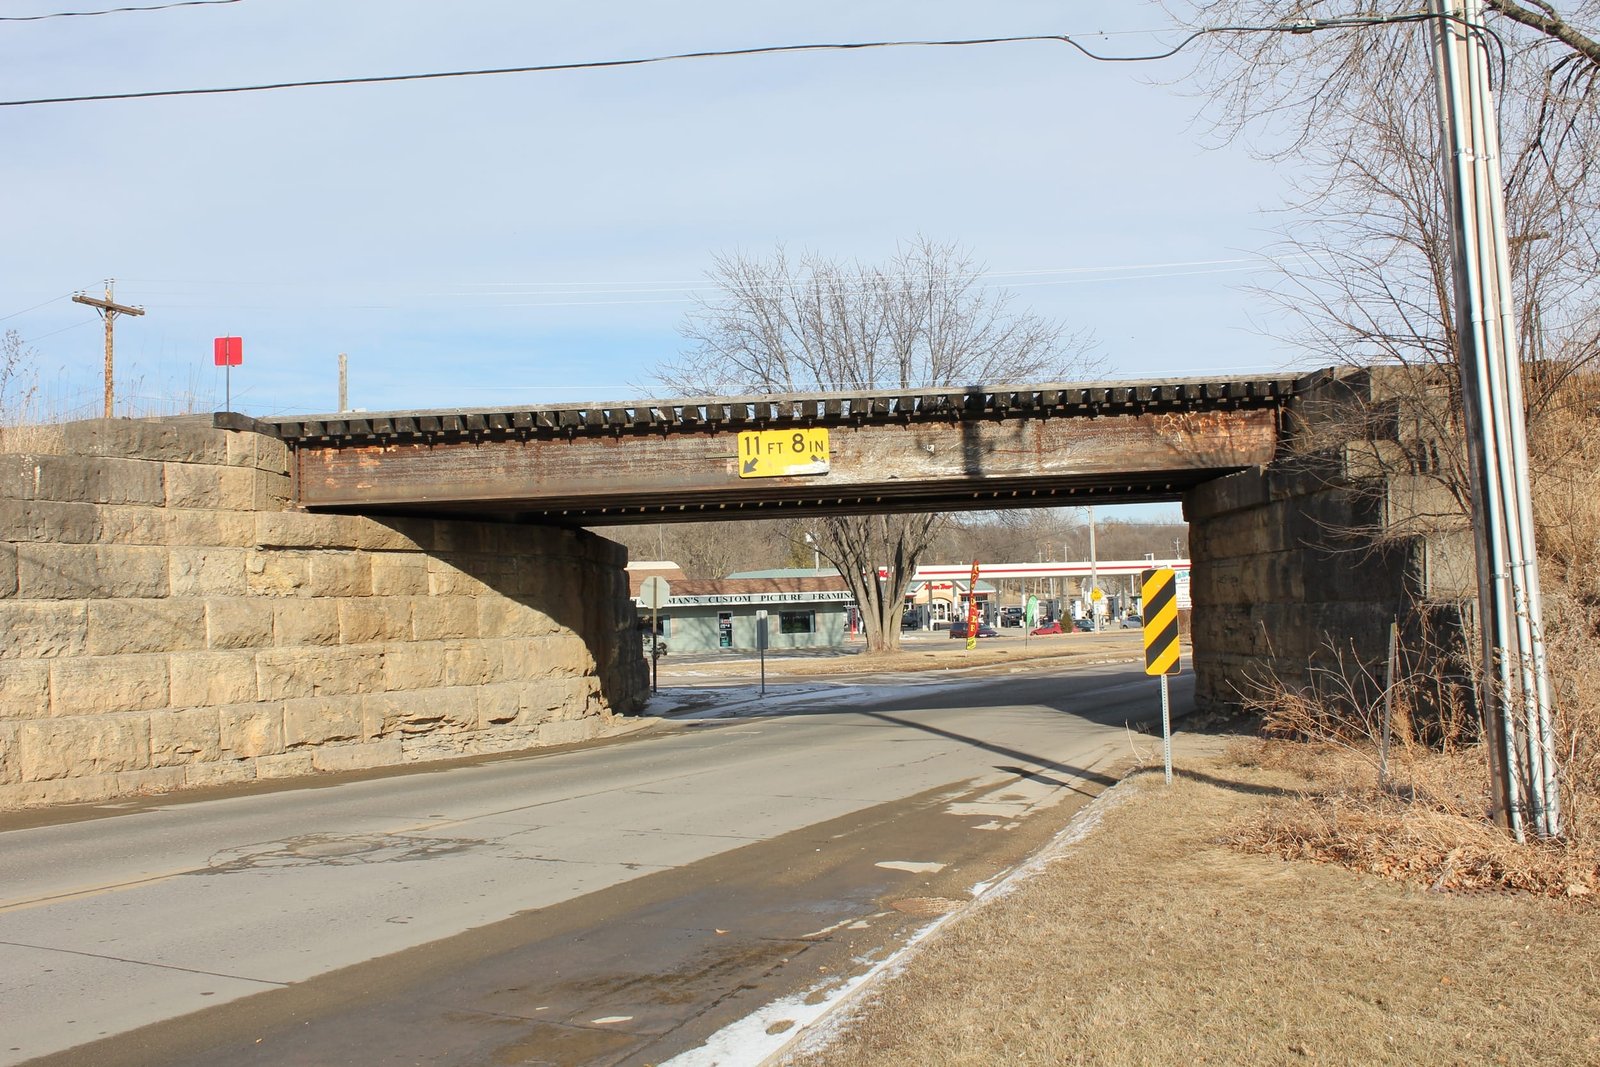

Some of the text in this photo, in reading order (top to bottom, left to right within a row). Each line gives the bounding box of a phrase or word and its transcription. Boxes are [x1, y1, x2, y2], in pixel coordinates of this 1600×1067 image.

[745, 433, 824, 455] 11 FT 8 IN
[707, 595, 752, 604] CUSTOM
[760, 594, 803, 602] PICTURE
